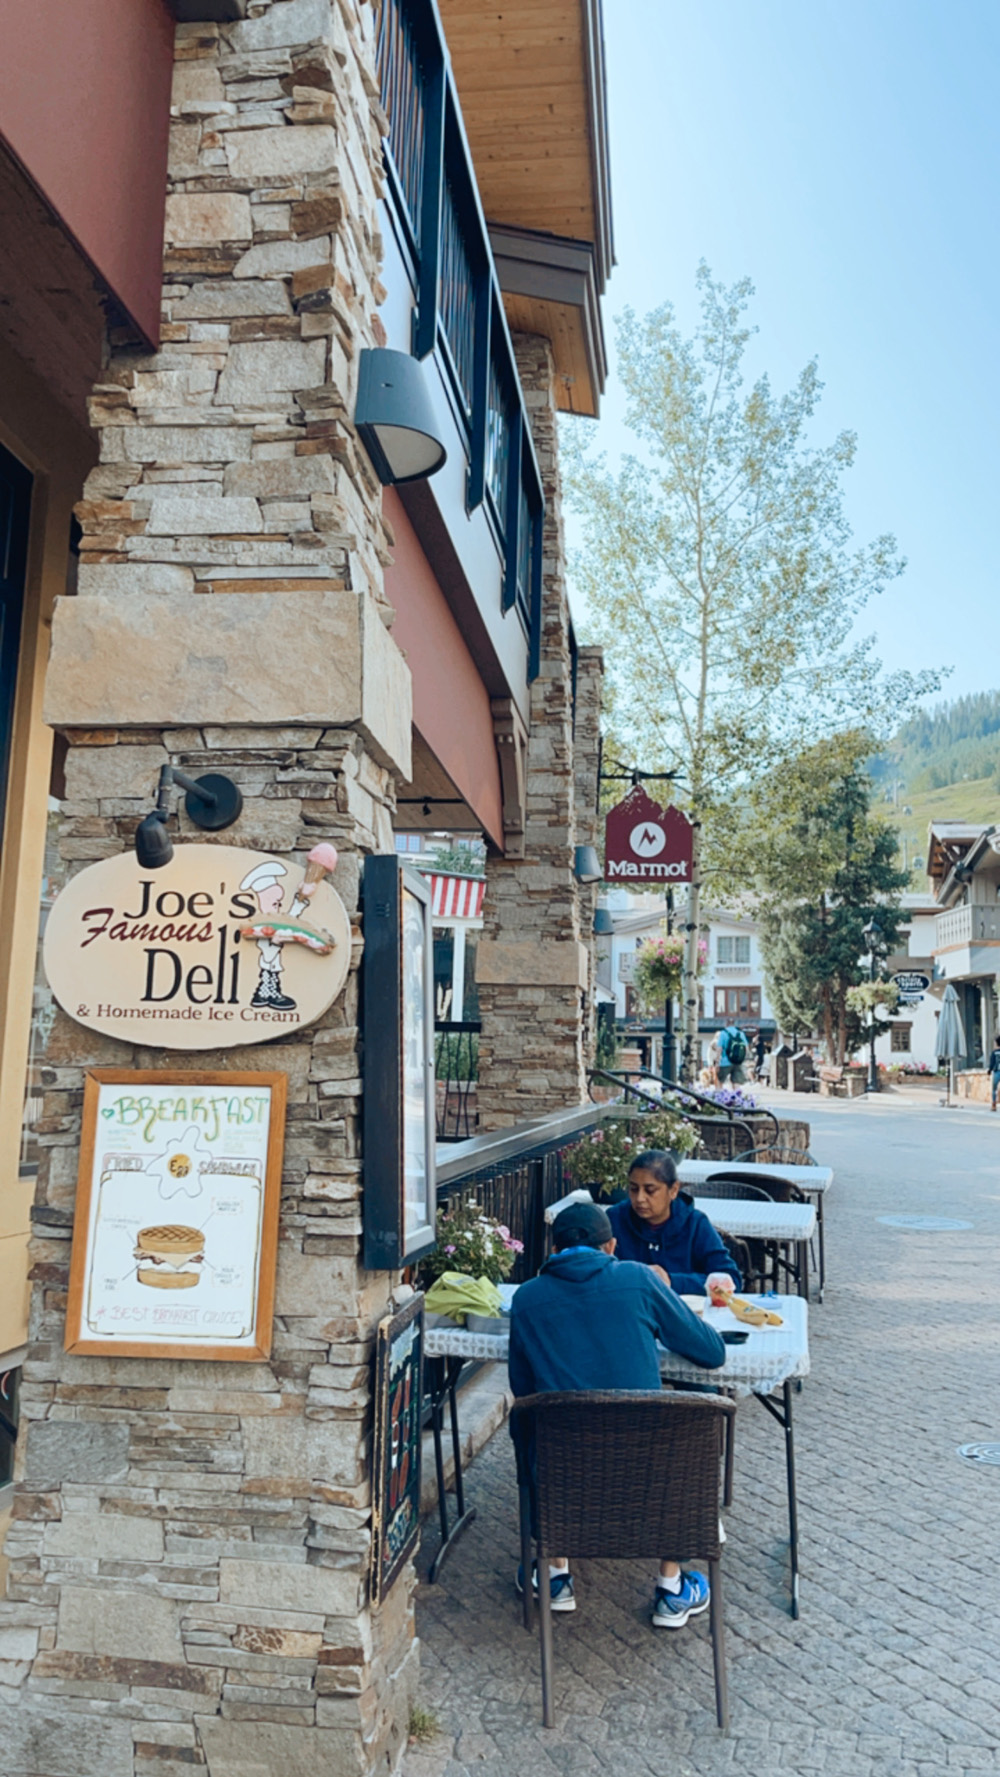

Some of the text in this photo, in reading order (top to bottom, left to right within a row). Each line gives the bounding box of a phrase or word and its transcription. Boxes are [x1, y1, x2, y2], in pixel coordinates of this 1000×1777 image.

[608, 860, 688, 877] Marmot
[123, 880, 257, 920] Joe's
[80, 907, 215, 948] Famous
[140, 924, 241, 1005] Deli
[76, 1004, 301, 1023] & Homemade Ice Cream
[112, 1096, 269, 1143] BREAKFAST
